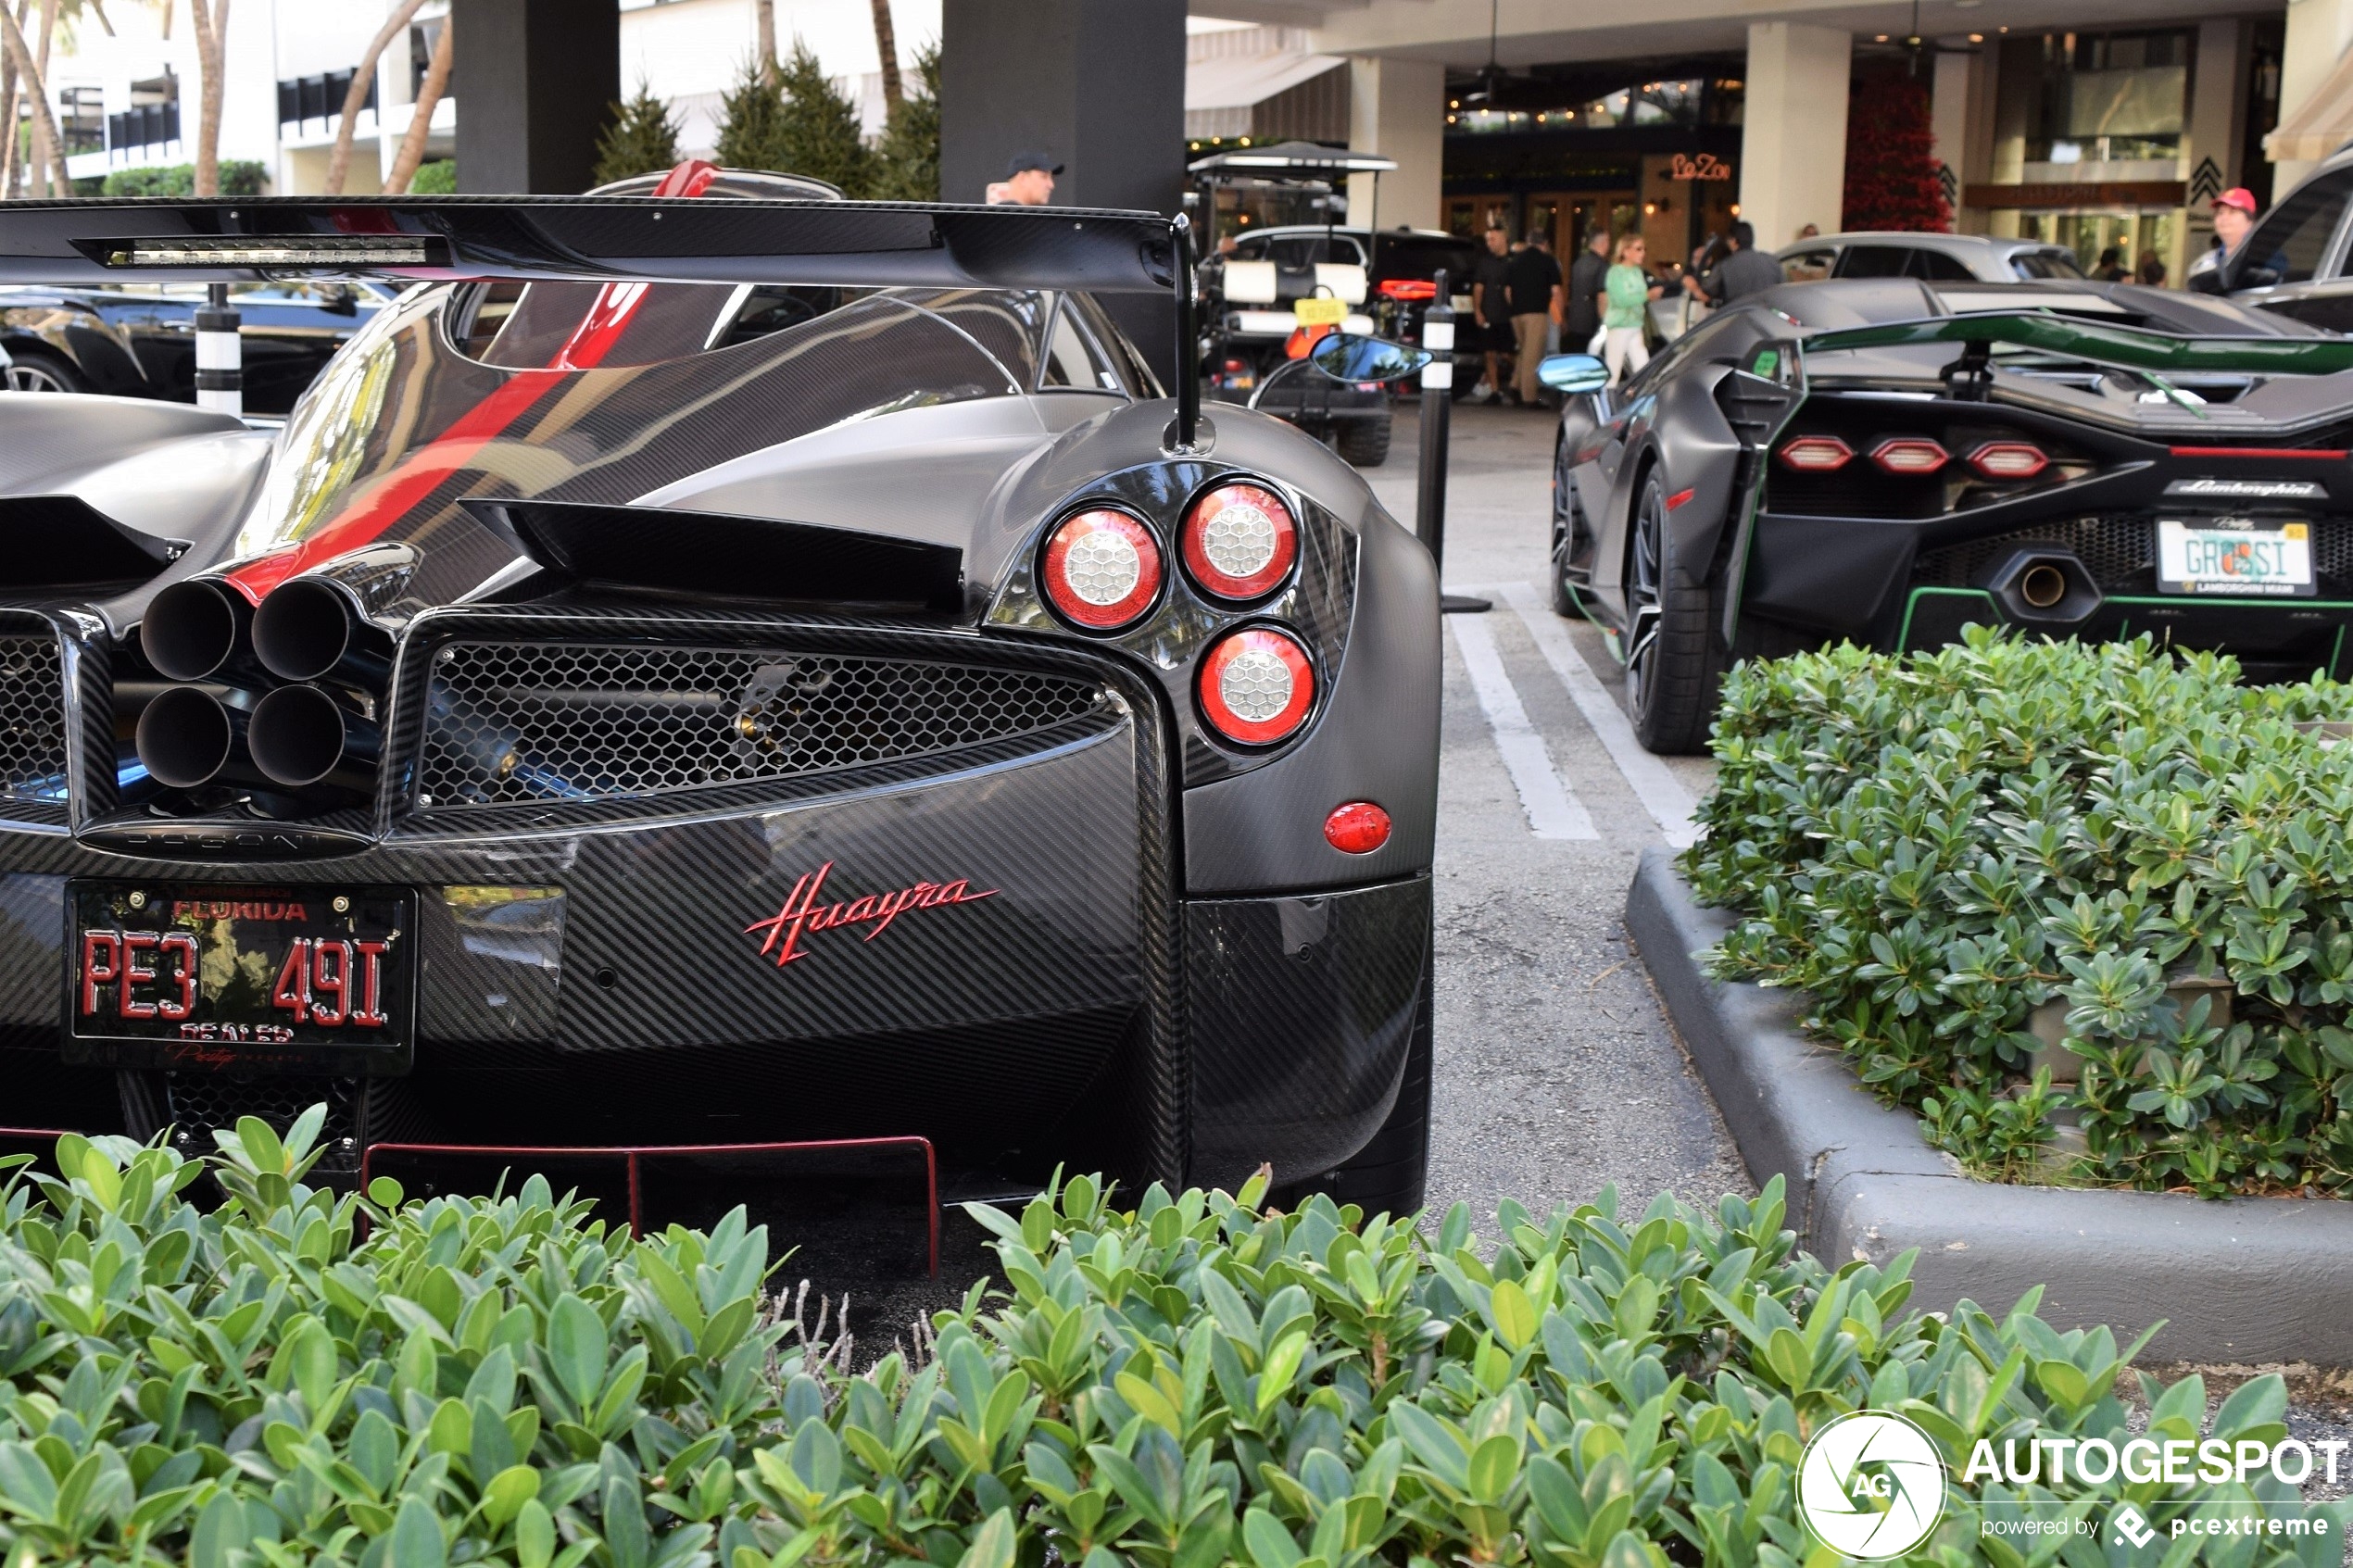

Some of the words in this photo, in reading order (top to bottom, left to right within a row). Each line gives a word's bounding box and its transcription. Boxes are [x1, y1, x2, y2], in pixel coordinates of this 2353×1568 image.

[2178, 480, 2315, 496] Lamborghini
[173, 900, 308, 922] FLORIDA
[743, 859, 1001, 968] Huayra
[83, 929, 201, 1019] PE3
